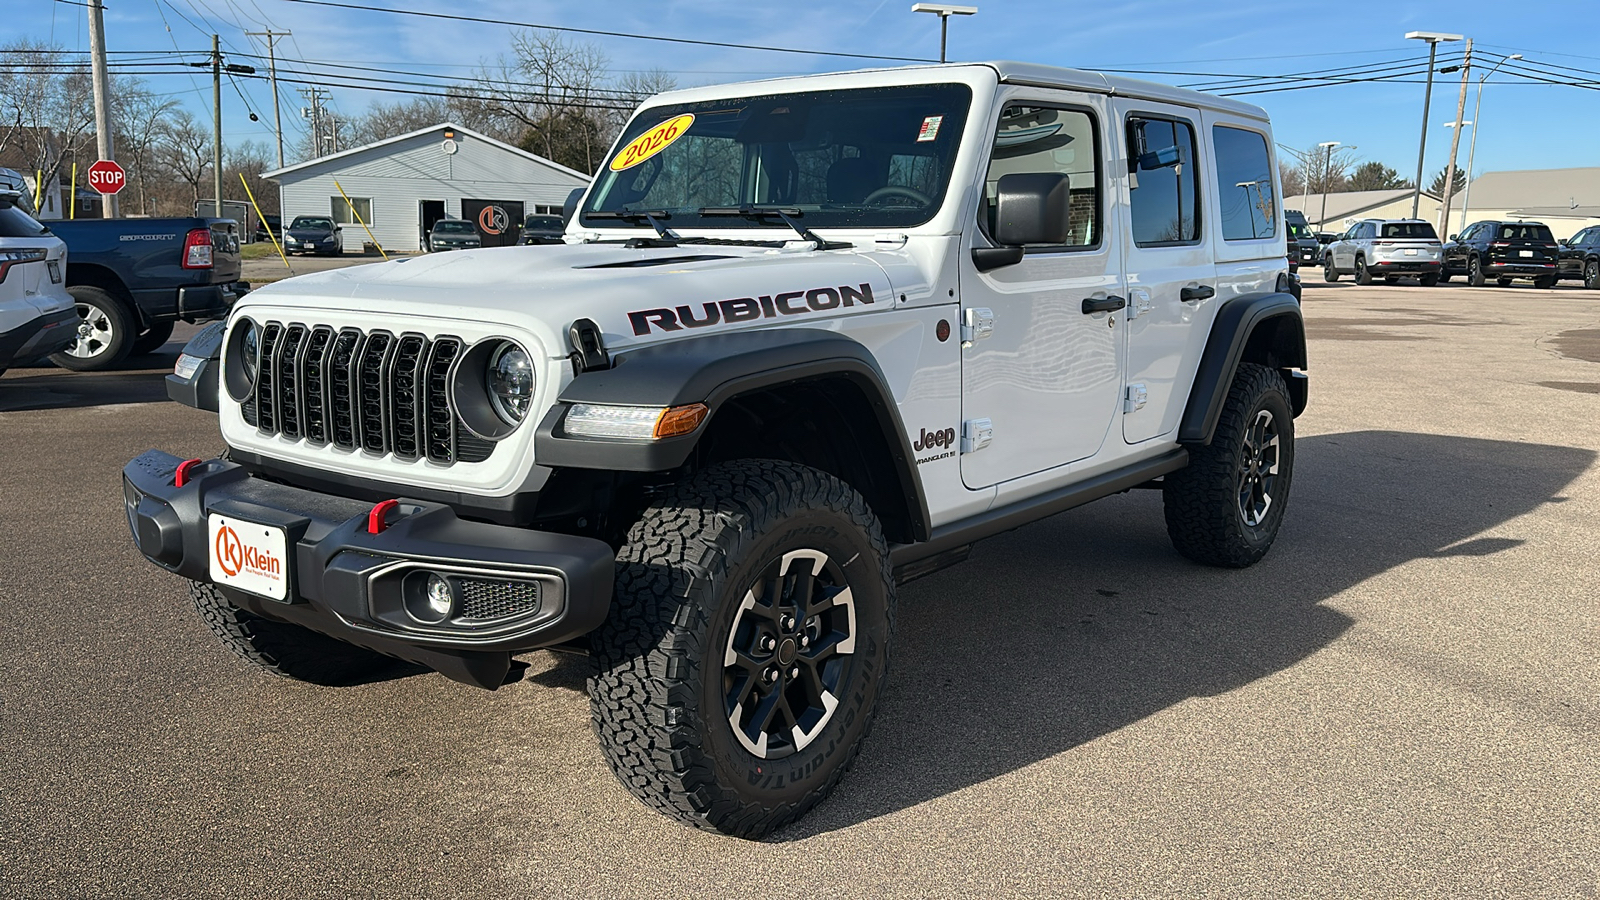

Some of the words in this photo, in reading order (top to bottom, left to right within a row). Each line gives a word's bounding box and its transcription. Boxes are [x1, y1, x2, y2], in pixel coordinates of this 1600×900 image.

[623, 119, 679, 167] 2026
[91, 170, 123, 184] STOP
[627, 283, 875, 336] RUBICON
[913, 427, 956, 452] Jeep
[243, 544, 280, 574] Klein
